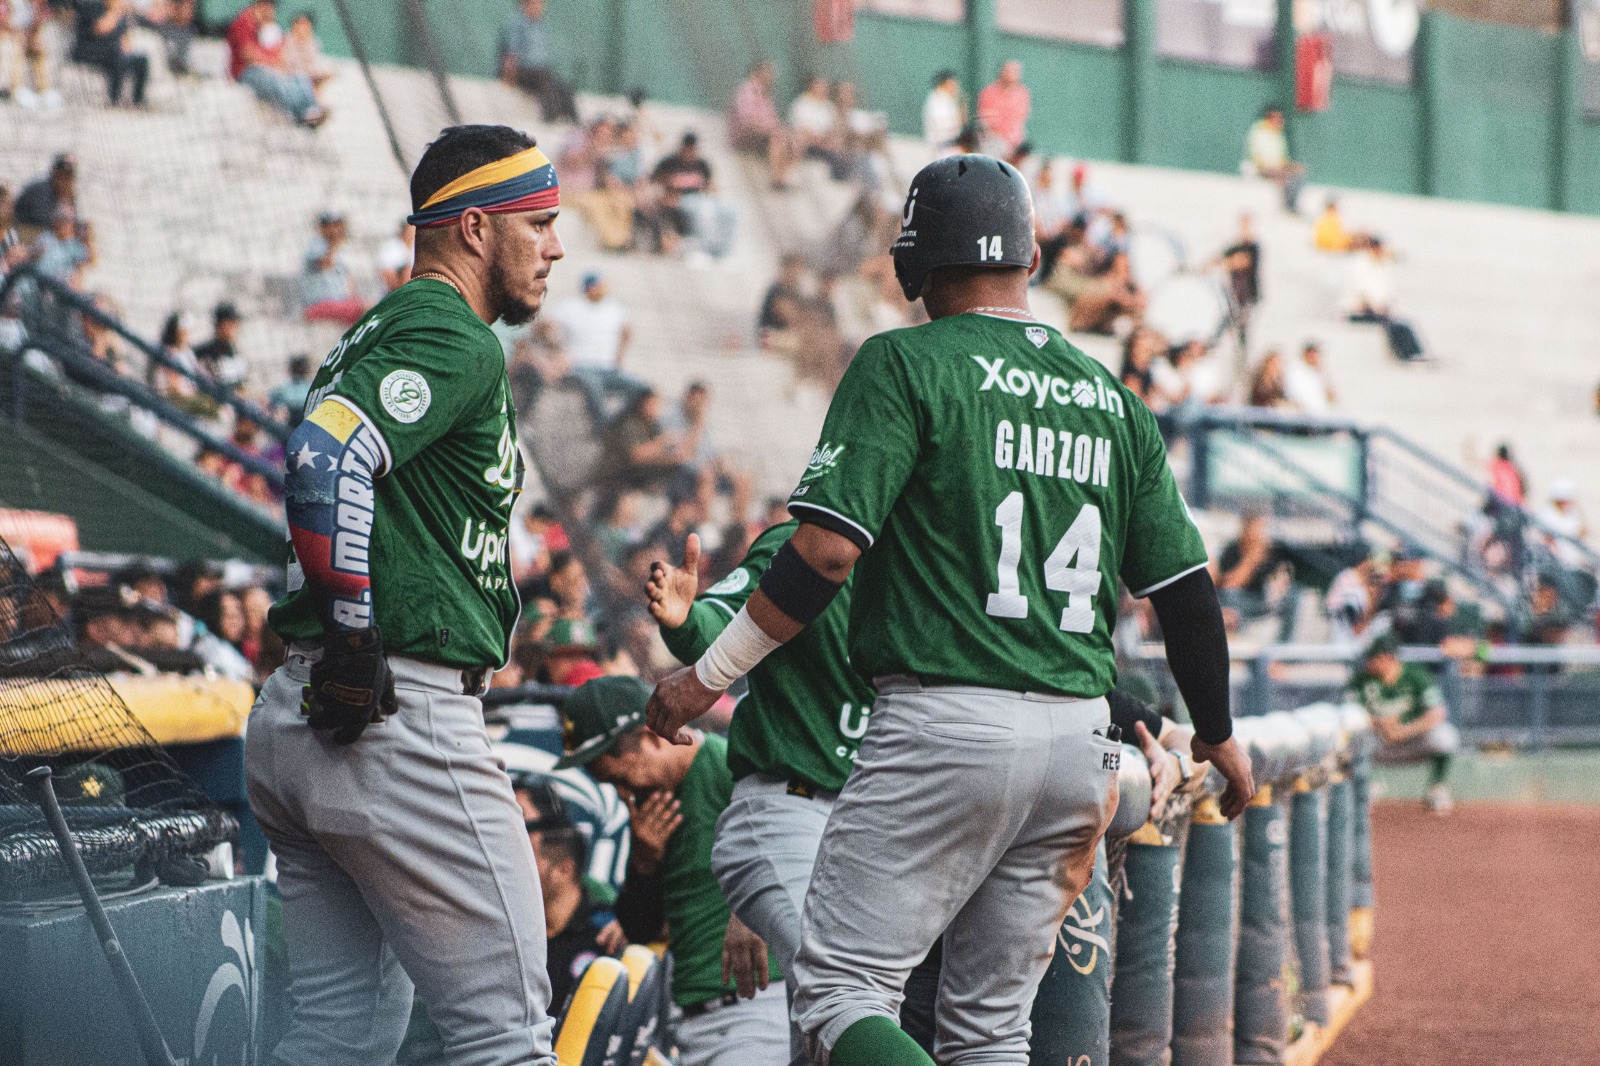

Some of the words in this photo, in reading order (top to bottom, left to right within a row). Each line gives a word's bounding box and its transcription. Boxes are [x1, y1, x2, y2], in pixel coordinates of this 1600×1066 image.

[976, 235, 1003, 261] 14
[969, 355, 1125, 419] Xoycoin
[994, 419, 1112, 488] GARZON
[985, 490, 1102, 634] 14
[333, 590, 371, 629] A.
